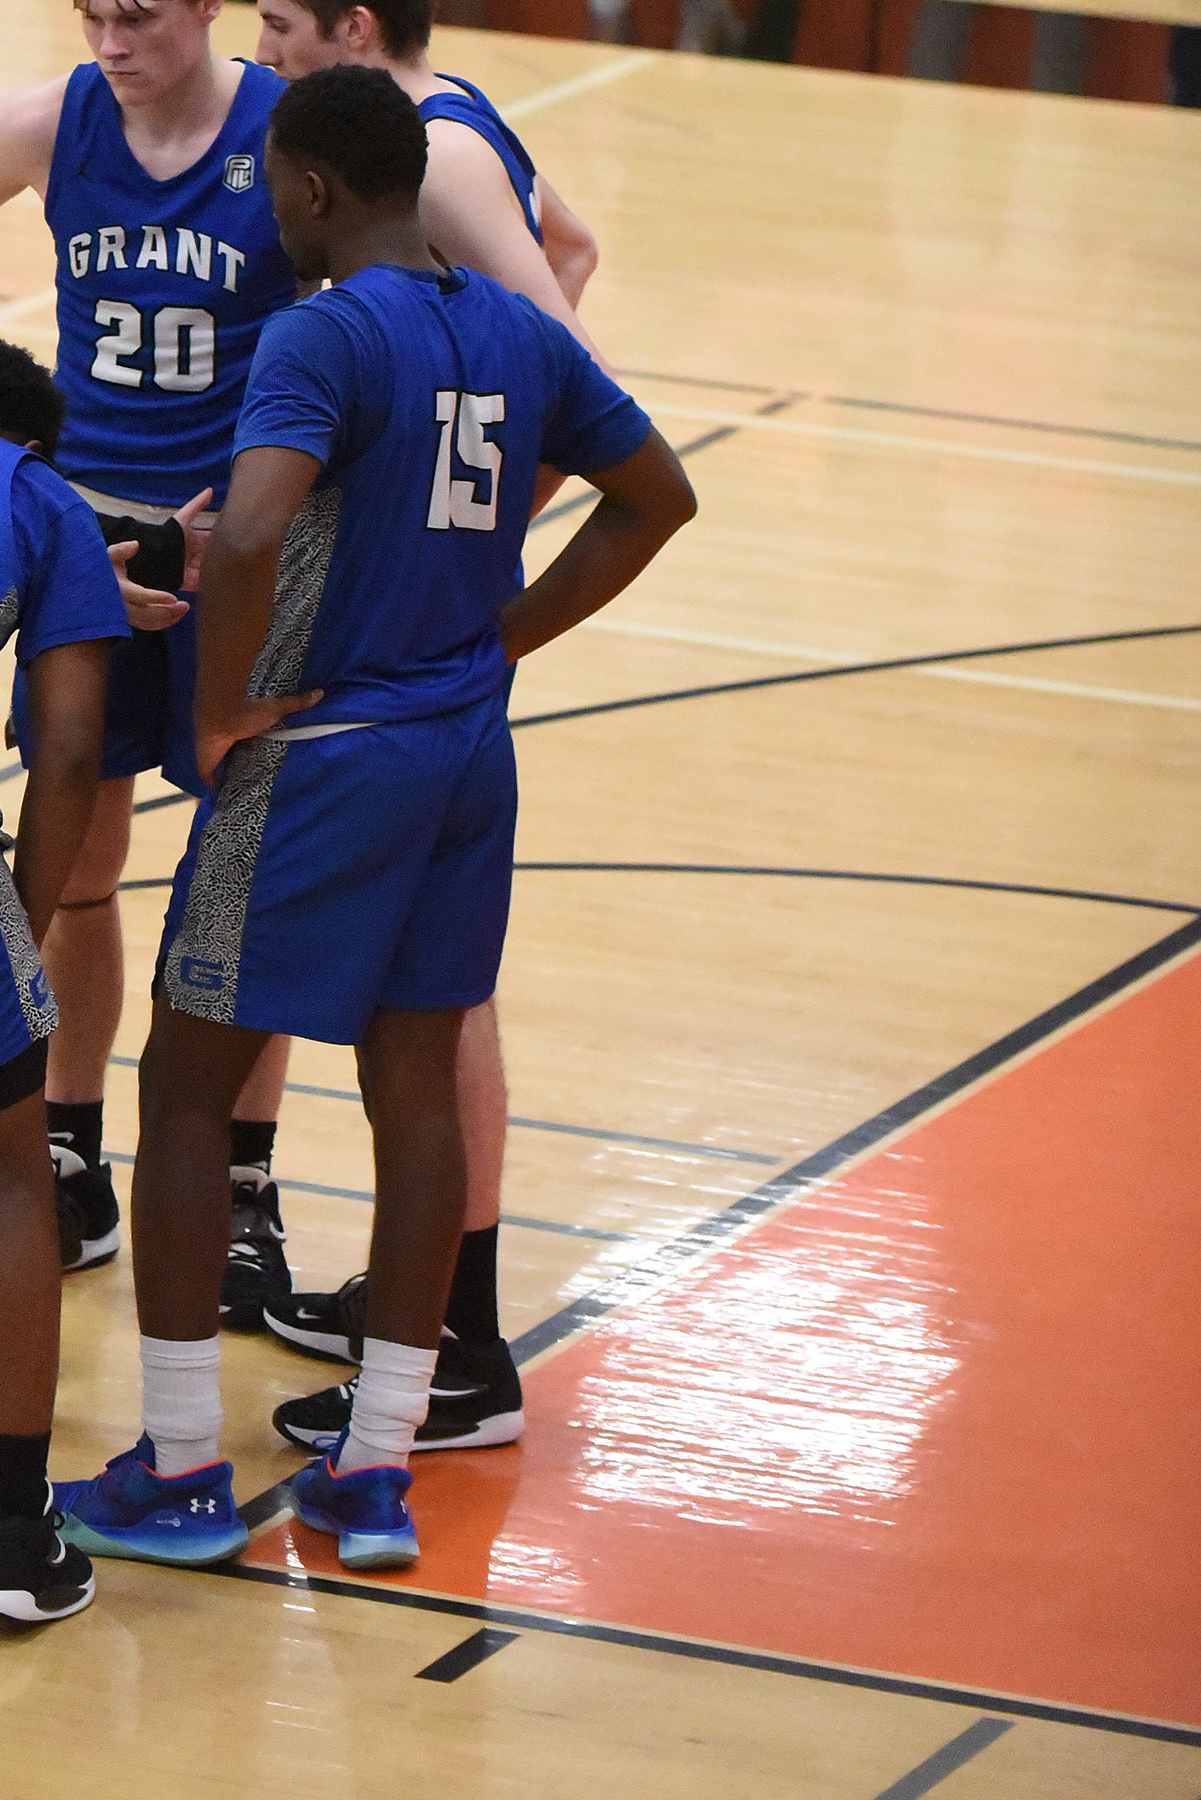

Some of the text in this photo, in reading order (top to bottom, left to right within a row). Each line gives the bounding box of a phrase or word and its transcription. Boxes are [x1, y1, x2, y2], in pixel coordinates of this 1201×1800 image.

[68, 225, 246, 294] GRANT
[90, 298, 215, 393] 20
[426, 390, 506, 532] 15
[180, 955, 225, 992] G
